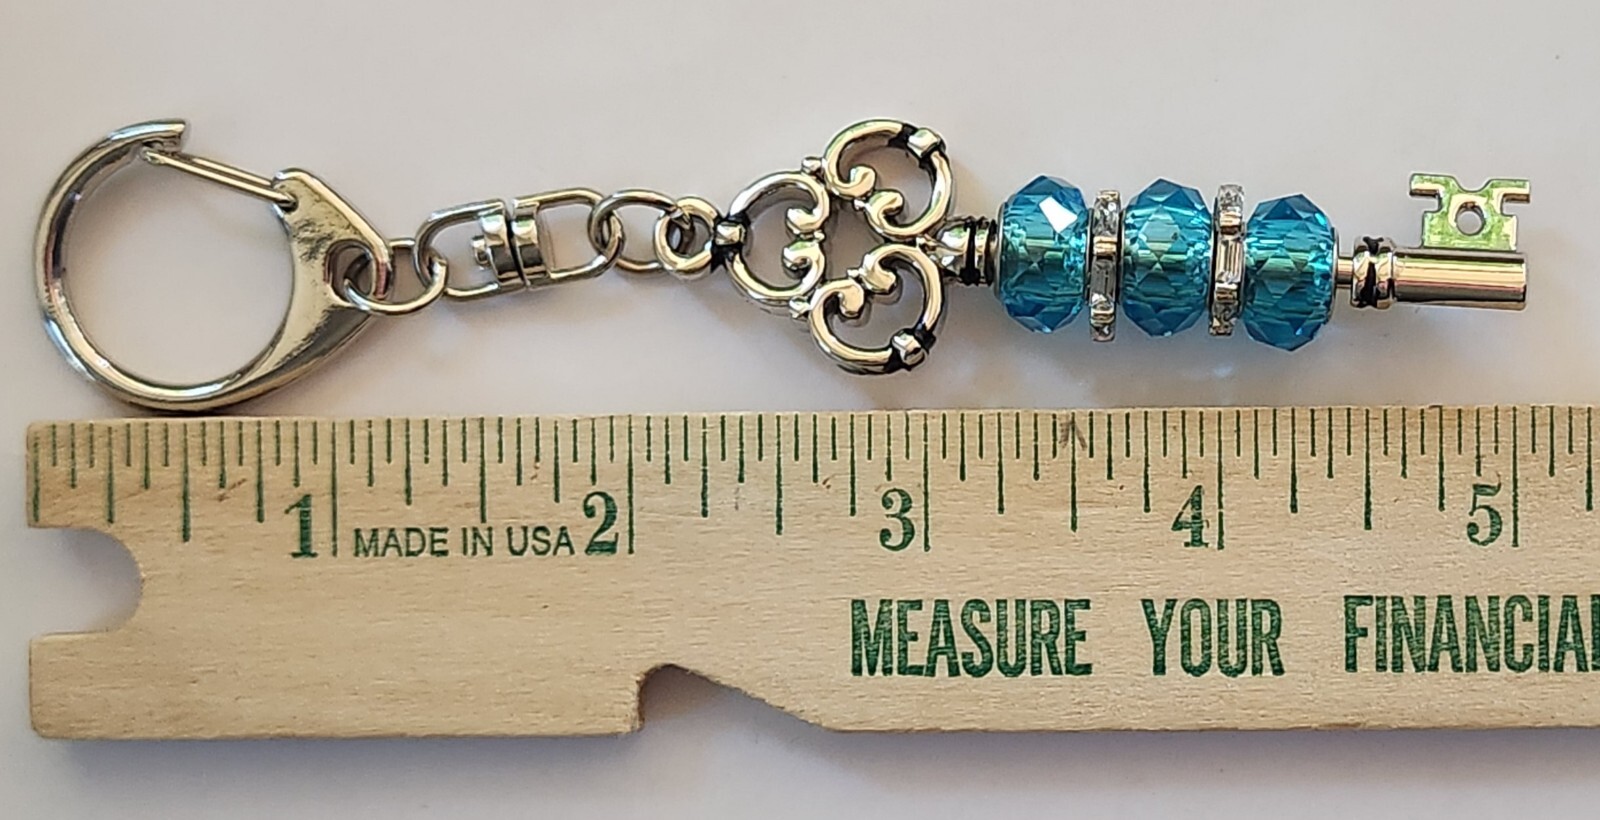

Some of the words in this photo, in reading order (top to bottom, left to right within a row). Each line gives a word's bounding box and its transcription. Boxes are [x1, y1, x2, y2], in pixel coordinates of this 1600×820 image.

[285, 494, 319, 559] 1
[352, 528, 449, 558] MADE
[460, 528, 495, 557] IN
[508, 526, 575, 557] USA
[582, 491, 620, 557] 2
[879, 489, 917, 553] 3
[1171, 486, 1209, 549] 4
[1466, 482, 1505, 547] 5
[851, 598, 1094, 678] MEASURE
[1141, 598, 1285, 678] YOUR
